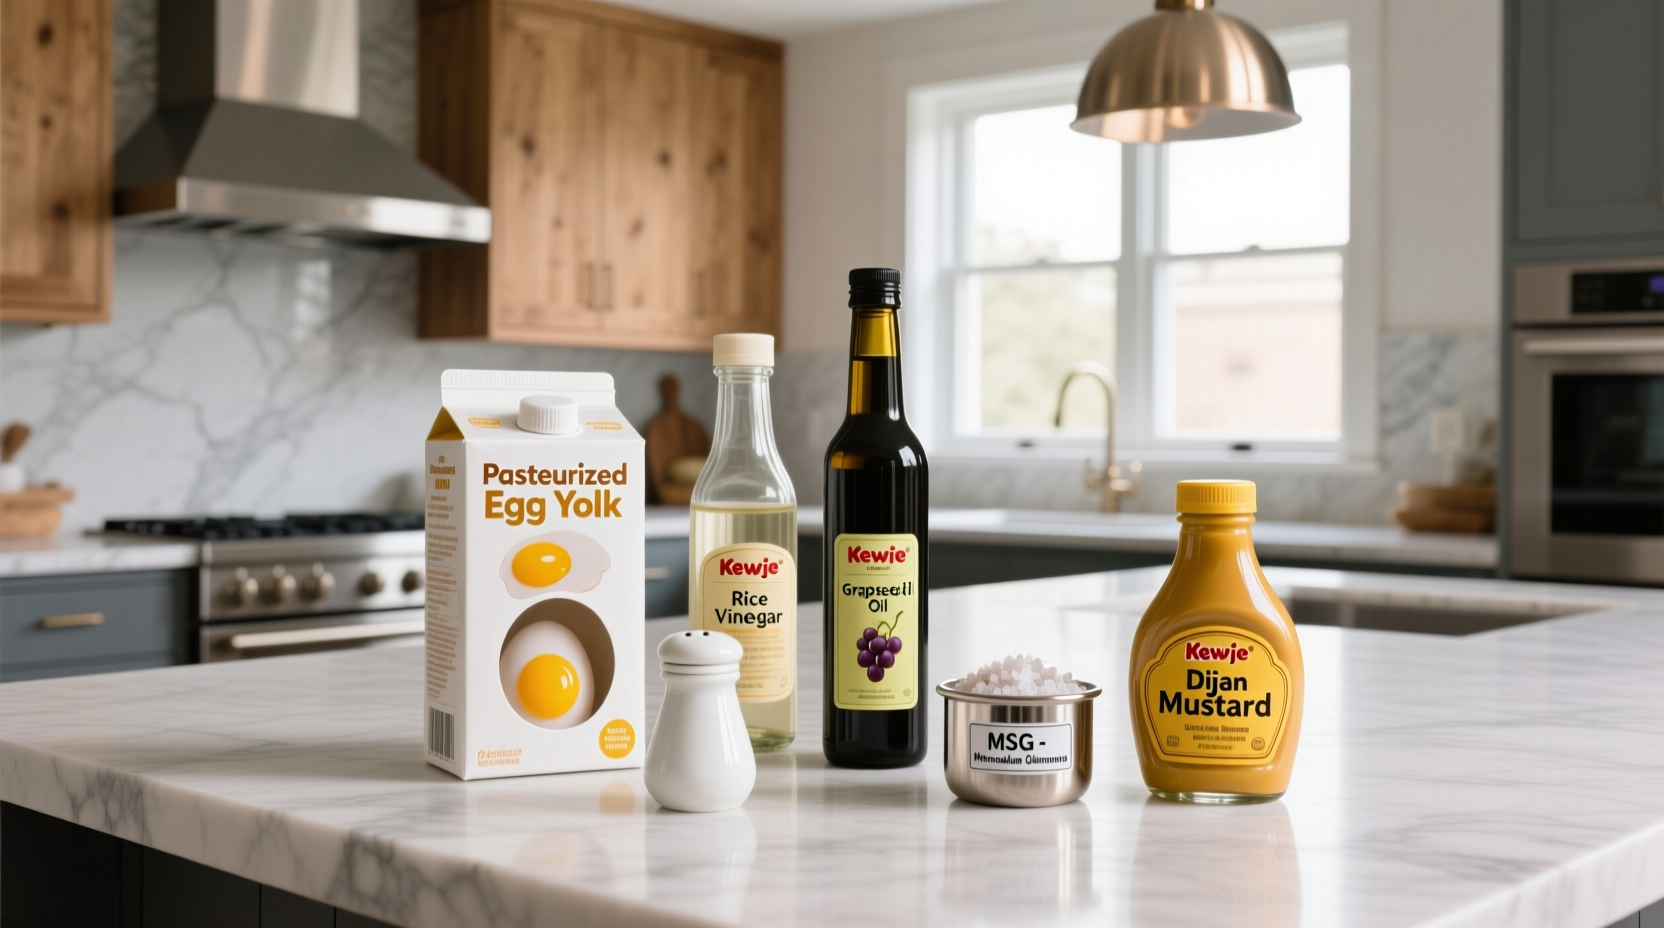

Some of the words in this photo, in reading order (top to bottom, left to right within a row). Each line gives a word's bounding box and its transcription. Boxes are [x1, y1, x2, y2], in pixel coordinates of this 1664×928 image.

[483, 462, 628, 486] Pasteurized
[484, 490, 546, 526] Egg
[553, 489, 623, 518] Yolk
[719, 557, 779, 579] Kewje
[732, 590, 768, 606] Rice
[714, 608, 783, 629] Vinegar
[1185, 642, 1249, 665] Kewje
[1186, 669, 1248, 697] Dijan
[1158, 690, 1271, 717] Mustard
[988, 732, 1034, 751] MSG
